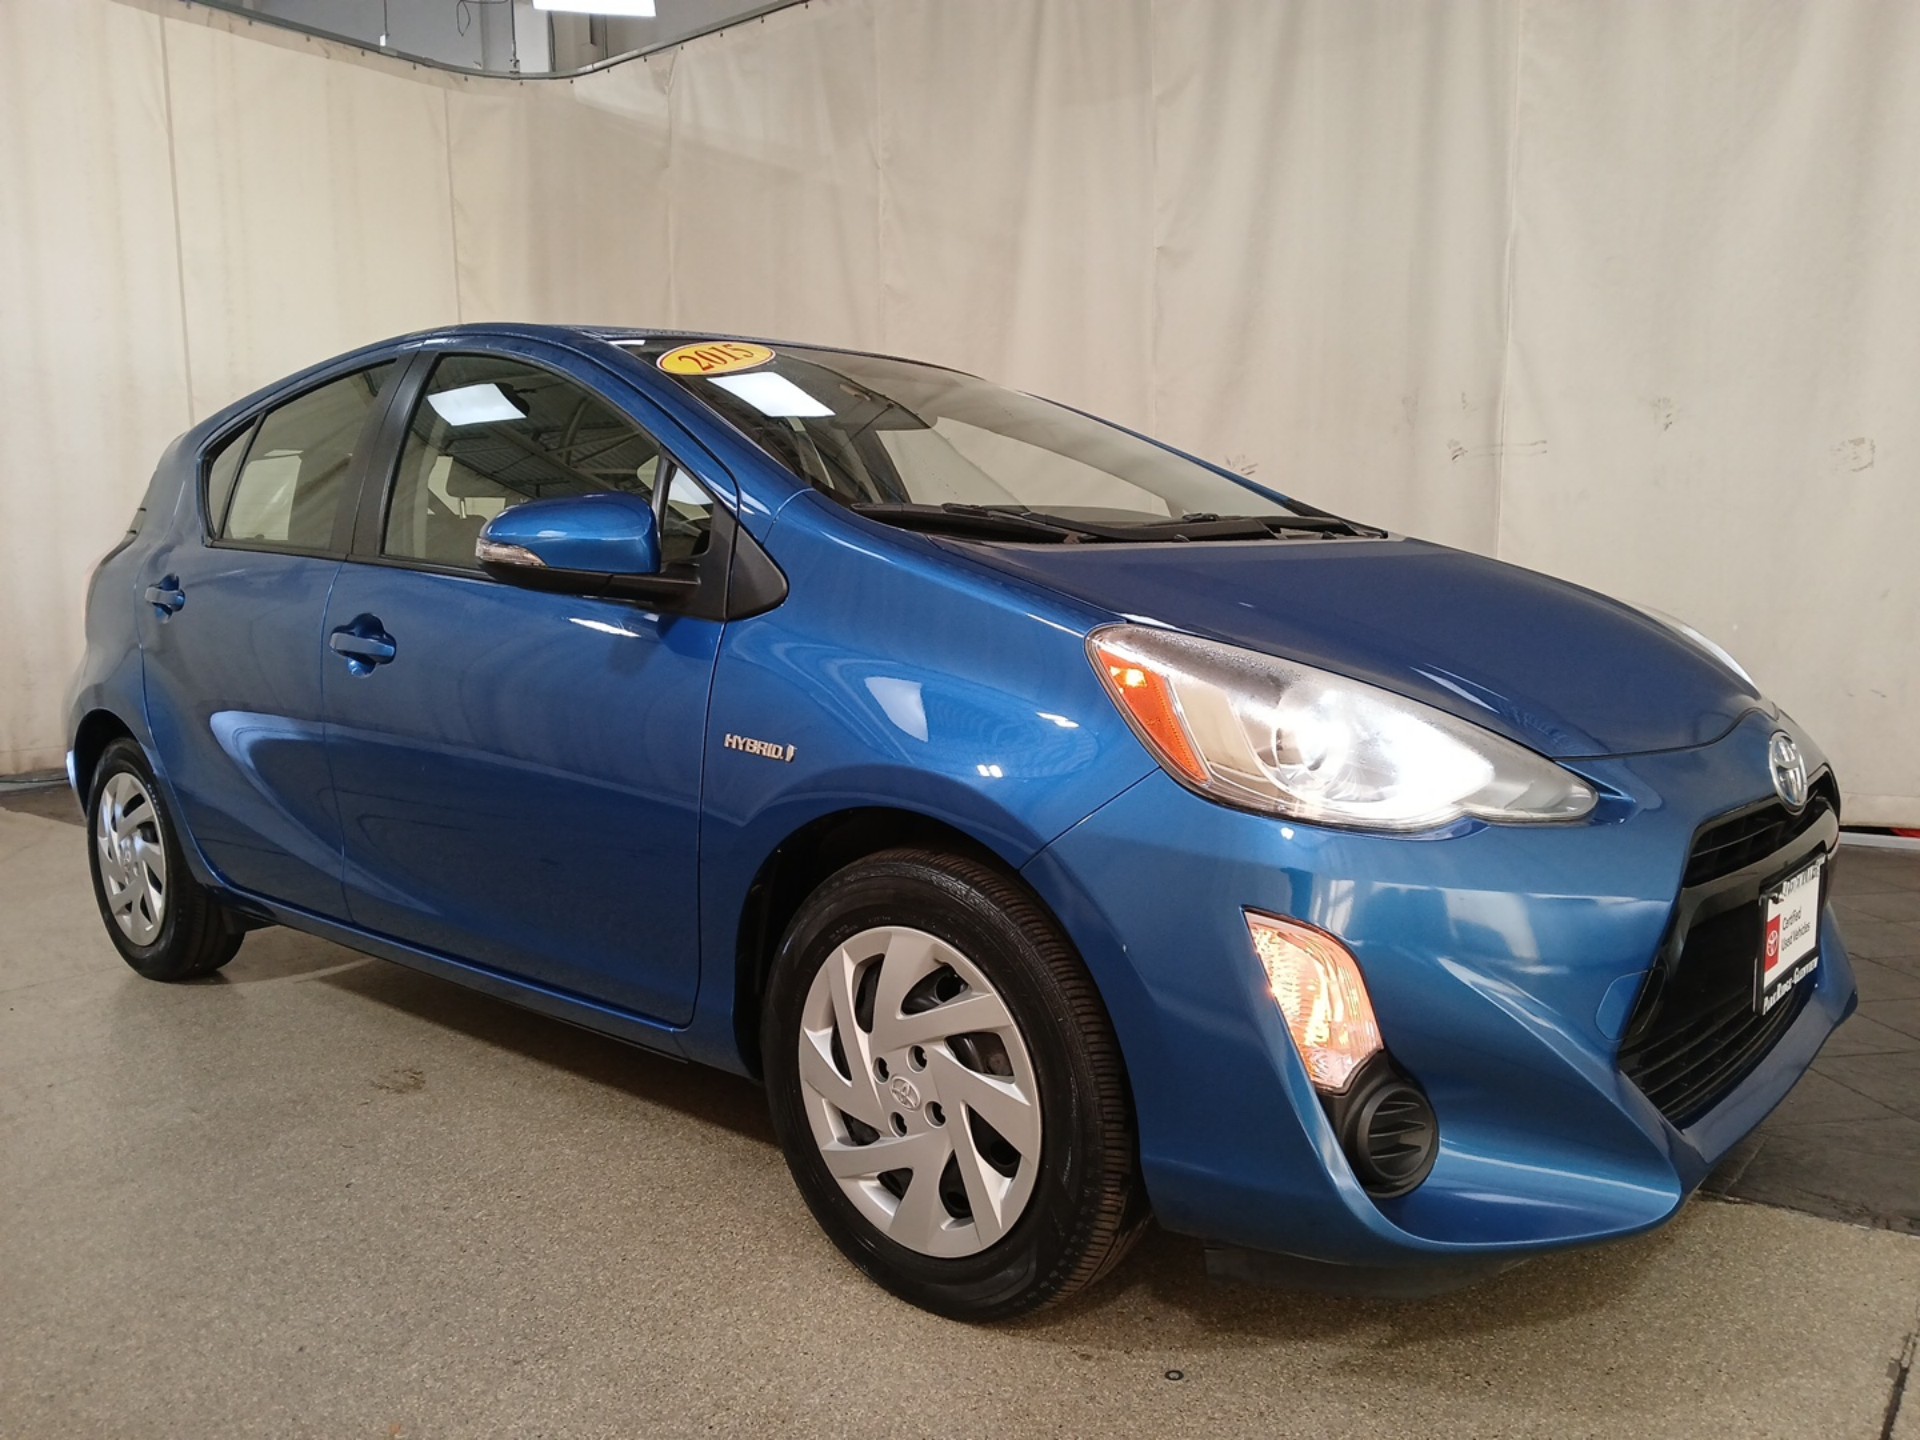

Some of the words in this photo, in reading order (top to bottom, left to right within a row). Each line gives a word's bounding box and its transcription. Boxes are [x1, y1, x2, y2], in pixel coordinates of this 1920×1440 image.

[678, 343, 754, 372] 2015
[723, 733, 784, 760] HYBRID
[1782, 905, 1802, 930] Certified
[1793, 921, 1810, 942] Vehicles
